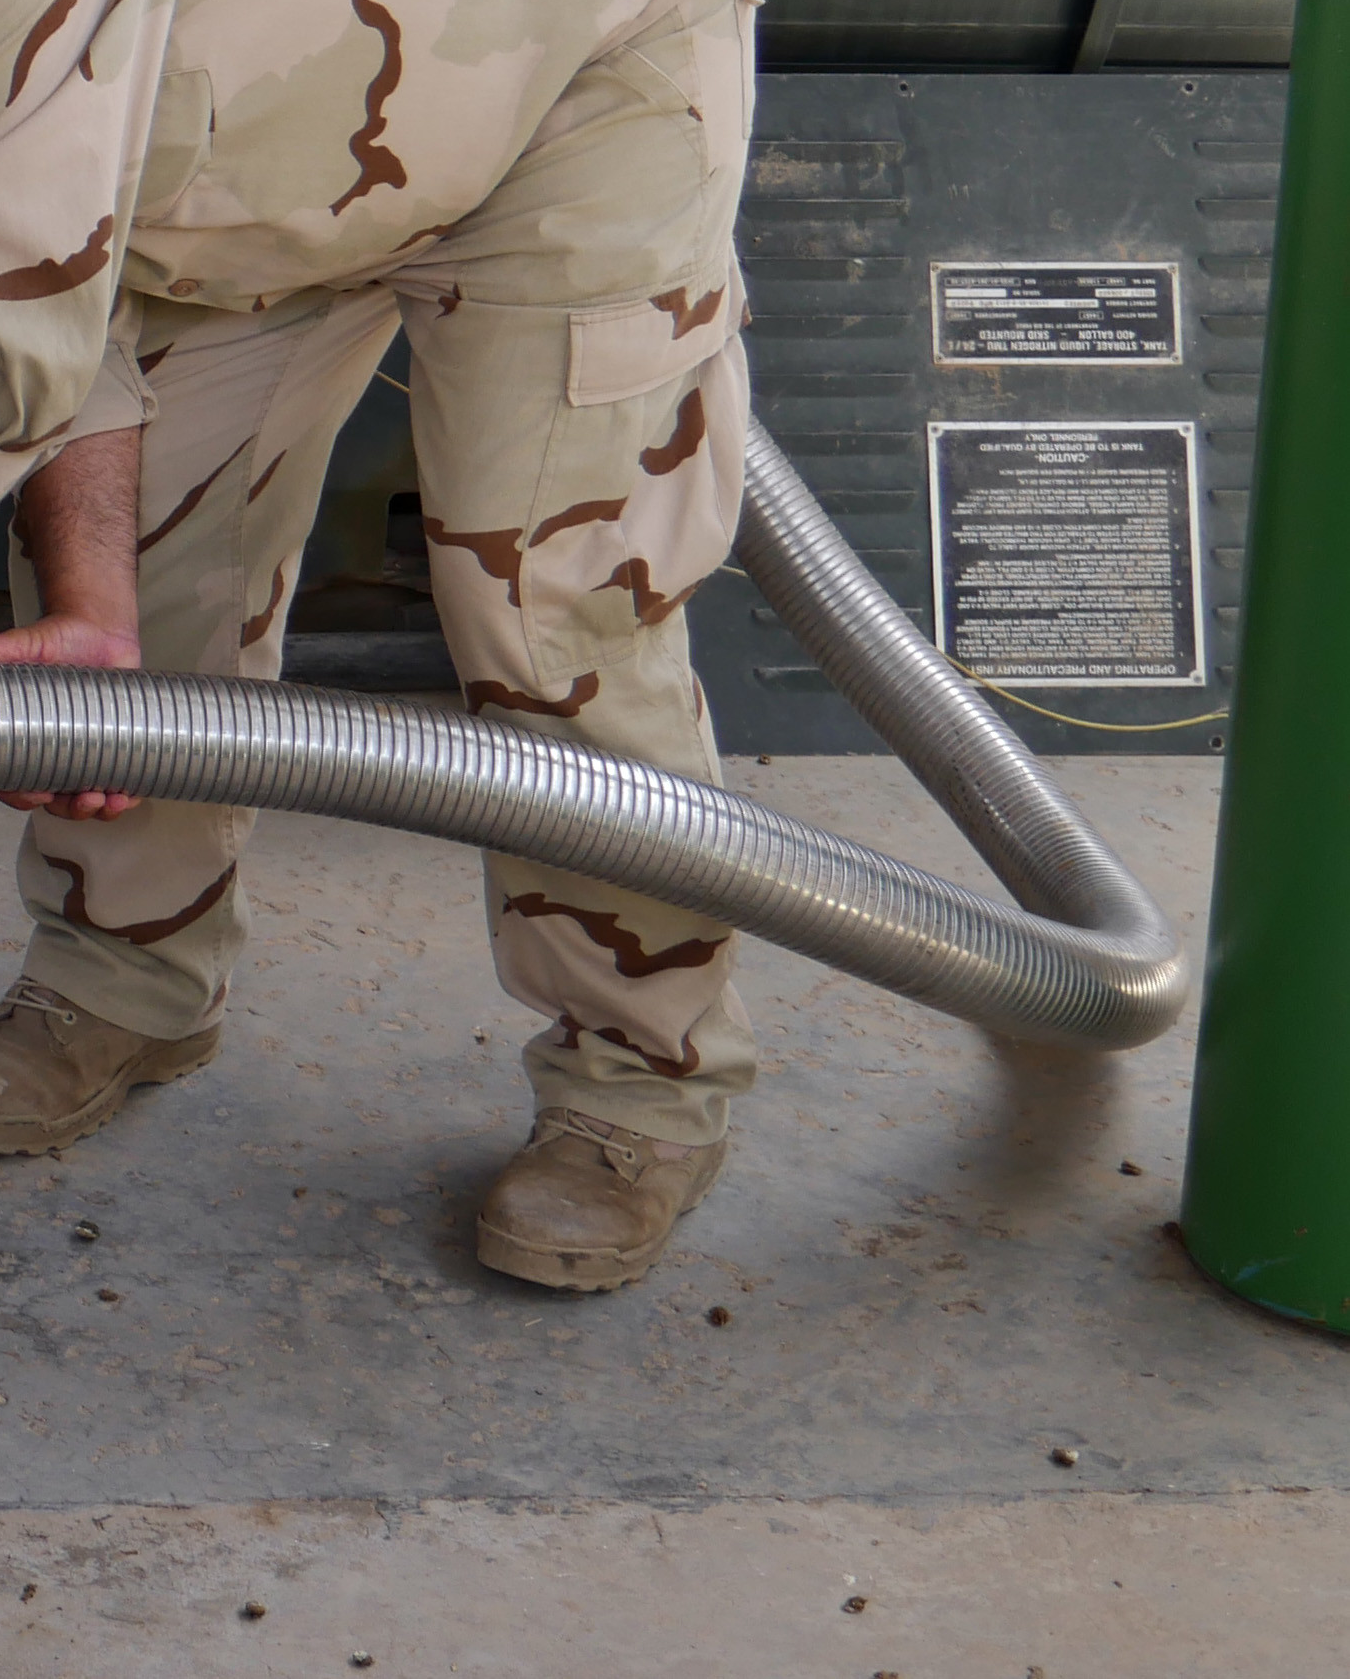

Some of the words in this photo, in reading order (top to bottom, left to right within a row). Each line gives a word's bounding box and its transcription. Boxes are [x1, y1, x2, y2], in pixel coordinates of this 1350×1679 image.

[979, 330, 1025, 339] MOUNTED
[1027, 330, 1050, 339] SKID
[1078, 330, 1114, 339] GALLON
[1116, 330, 1136, 339] 400
[1010, 340, 1056, 351] NITROGEN
[1059, 340, 1090, 351] LIQUID
[1092, 340, 1137, 351] STORAGE,
[1140, 340, 1167, 351] TANK,
[1025, 433, 1048, 442] ONLY
[1050, 433, 1099, 442] PERSONNEL
[979, 443, 1023, 452] QUALIFIED
[1025, 443, 1037, 452] BY
[1039, 443, 1082, 452] OPERATED
[1083, 443, 1096, 452] BE
[1097, 443, 1109, 452] TO
[1111, 443, 1119, 452] IS
[1121, 443, 1144, 452] TANK
[995, 664, 1086, 675] PRECAUTIONARY
[1088, 664, 1111, 675] AND
[1114, 664, 1176, 675] OPERATING
